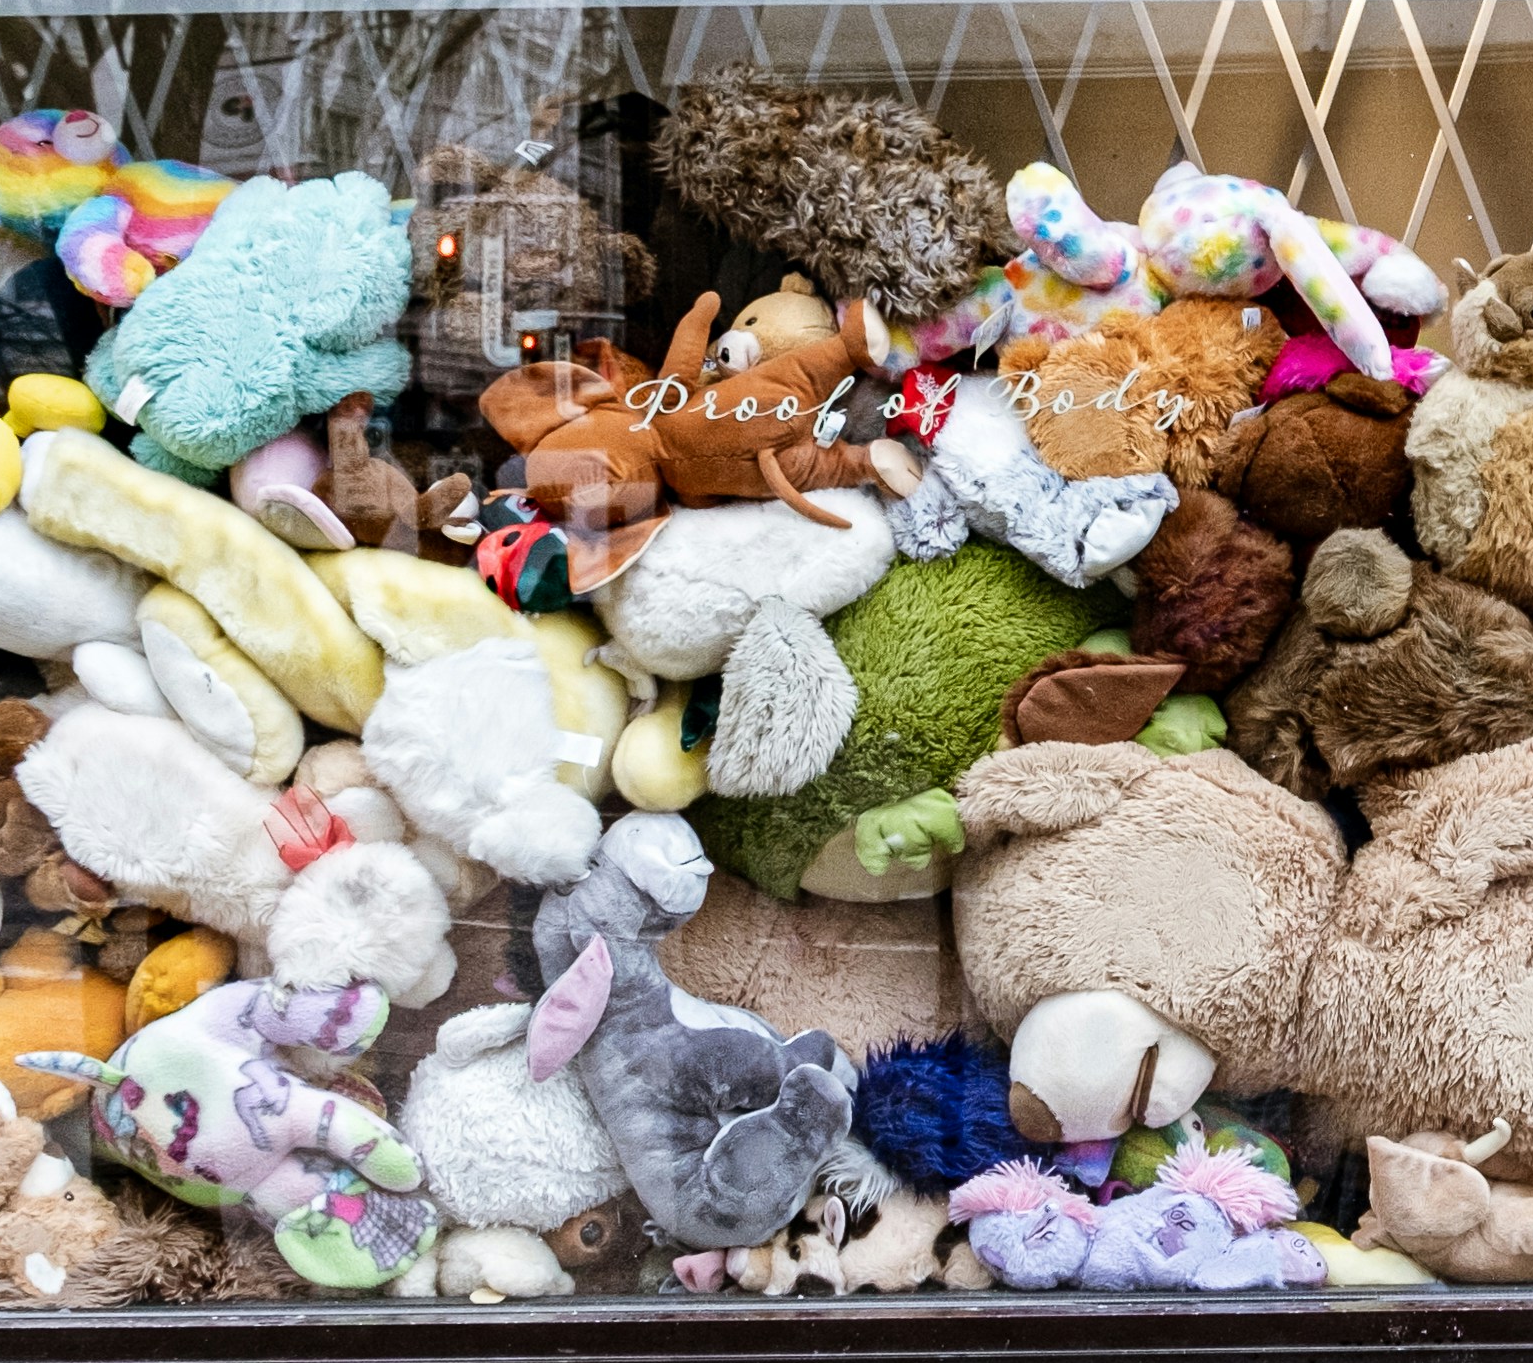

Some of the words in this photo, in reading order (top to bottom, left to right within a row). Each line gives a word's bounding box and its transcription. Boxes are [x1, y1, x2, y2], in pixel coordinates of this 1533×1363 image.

[624, 373, 856, 433] Proof
[876, 372, 962, 436] of
[985, 368, 1195, 431] Body
